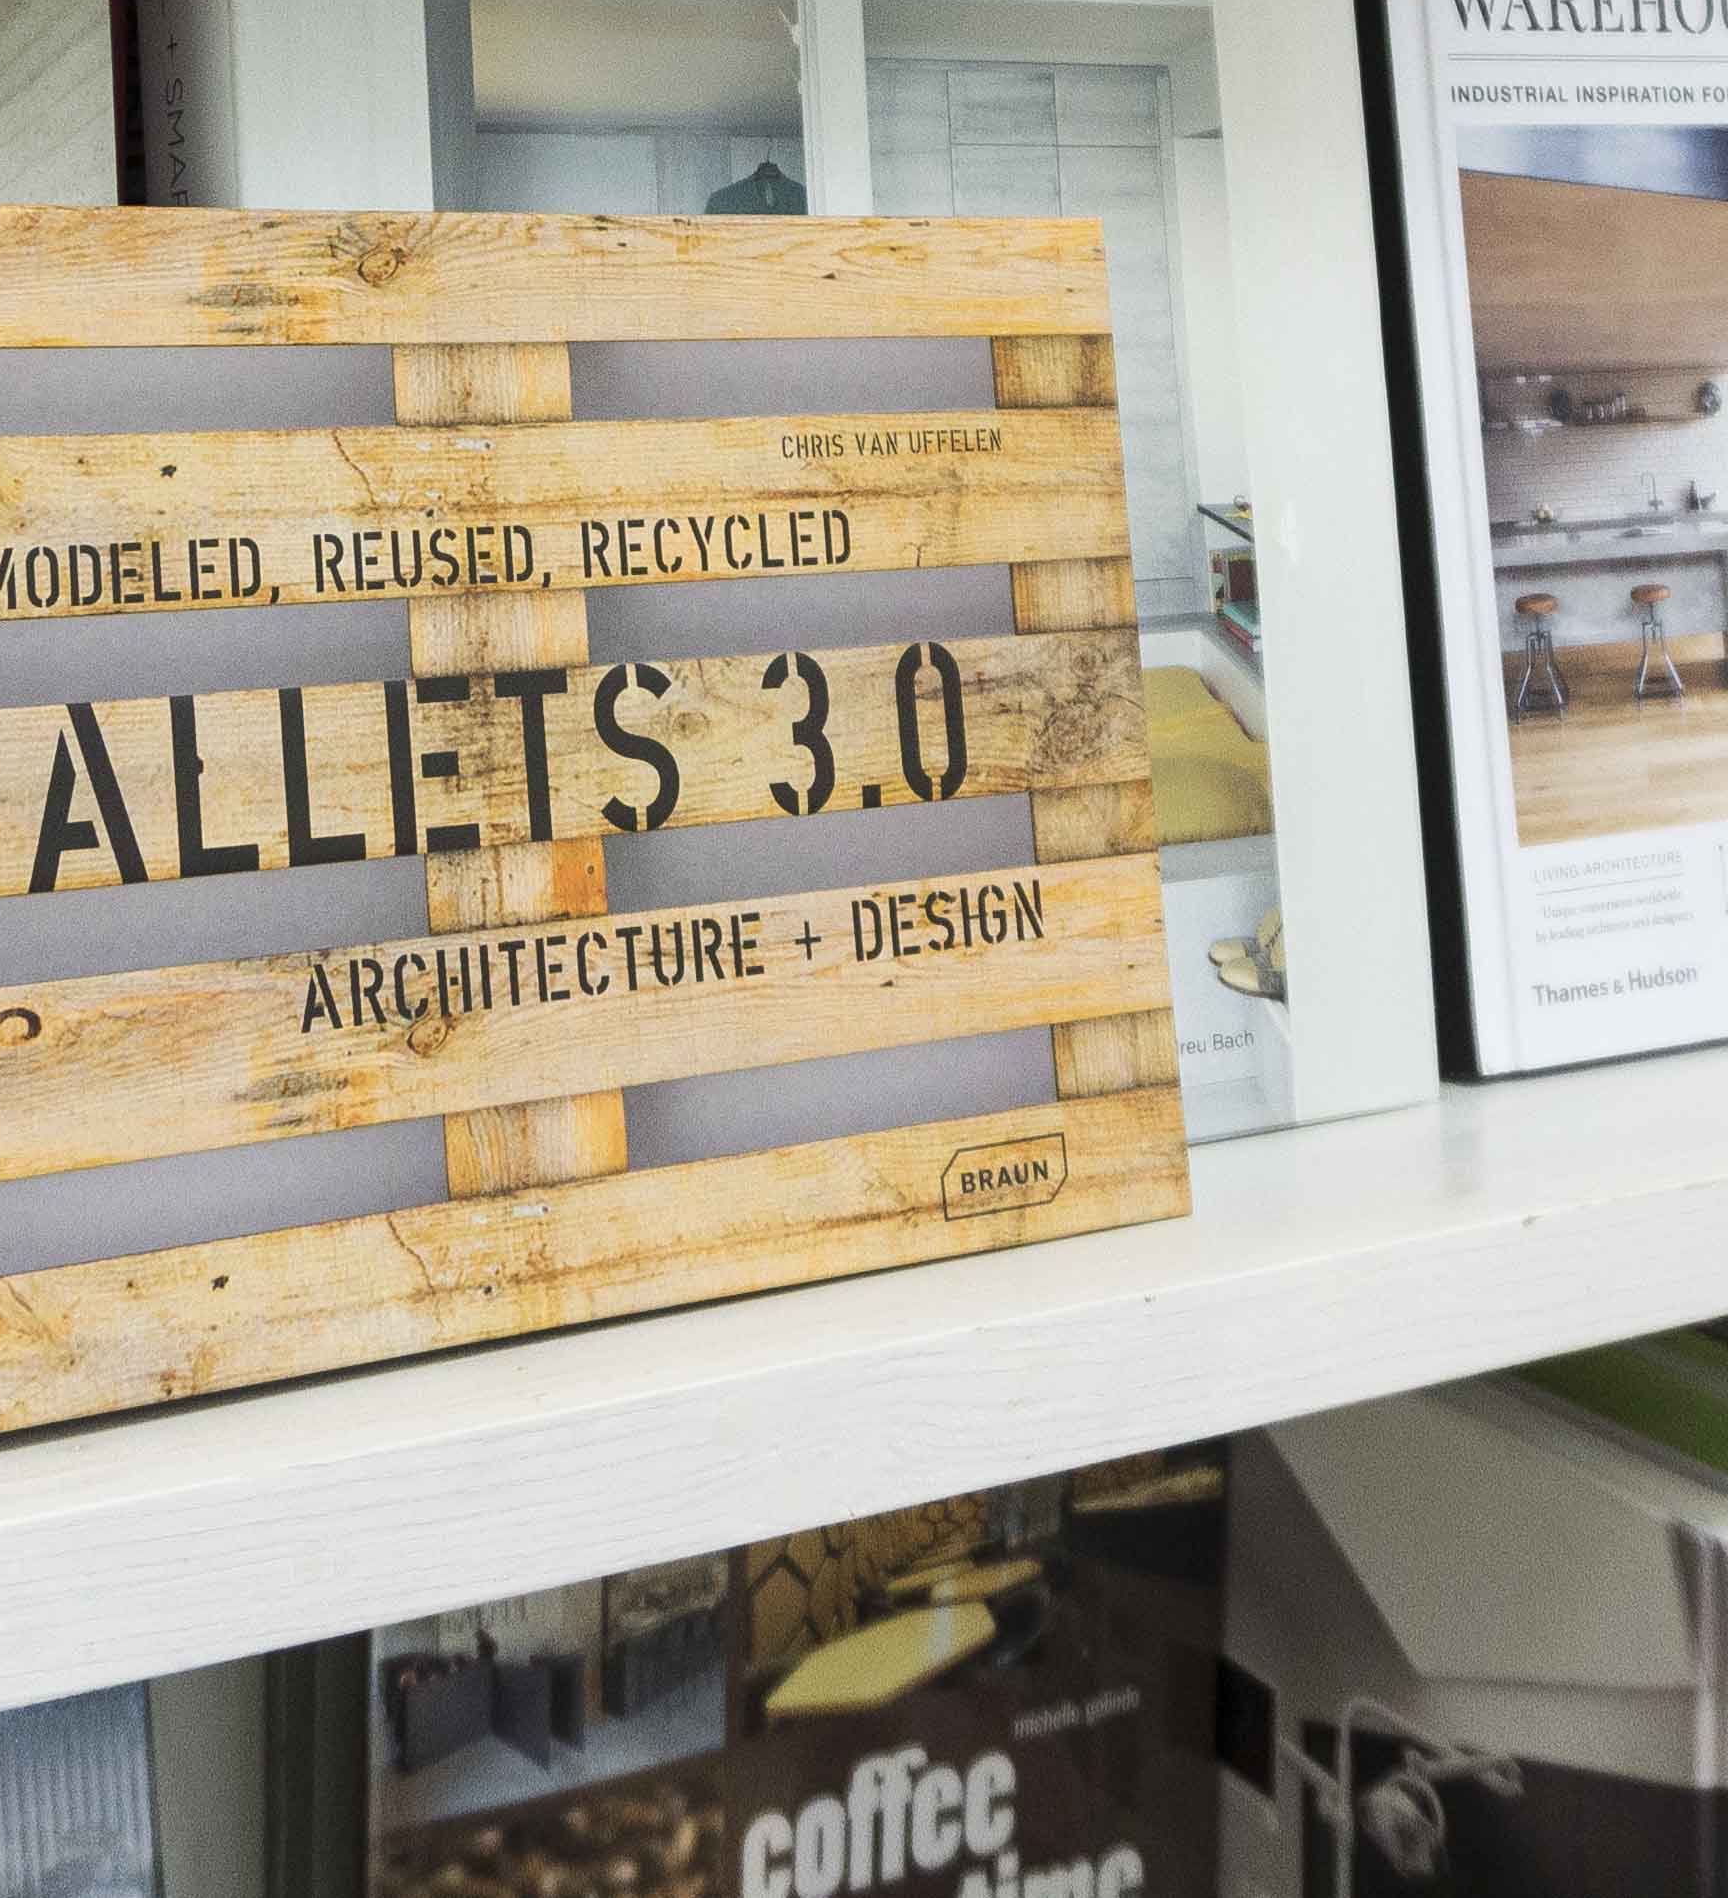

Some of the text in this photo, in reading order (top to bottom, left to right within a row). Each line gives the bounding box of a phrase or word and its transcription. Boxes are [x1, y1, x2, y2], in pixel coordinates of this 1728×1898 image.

[1450, 85, 1568, 103] INDUSTRIAL
[1575, 85, 1695, 103] INSPIRATION
[781, 426, 1004, 461] CHRIS VAN UFFELEN
[313, 524, 552, 600] REUSED,
[582, 508, 852, 580] RECYCLED
[767, 641, 969, 816] 3.0
[1534, 850, 1682, 884] LIVING ARCHITECTURE
[300, 879, 1045, 1036] ARCHITECTURE + DESIGN
[1533, 963, 1698, 1006] Thames & Hudson
[1178, 1030, 1254, 1055] reu Bach
[959, 1159, 1051, 1198] BRAUN
[742, 1742, 1016, 1898] coffee
